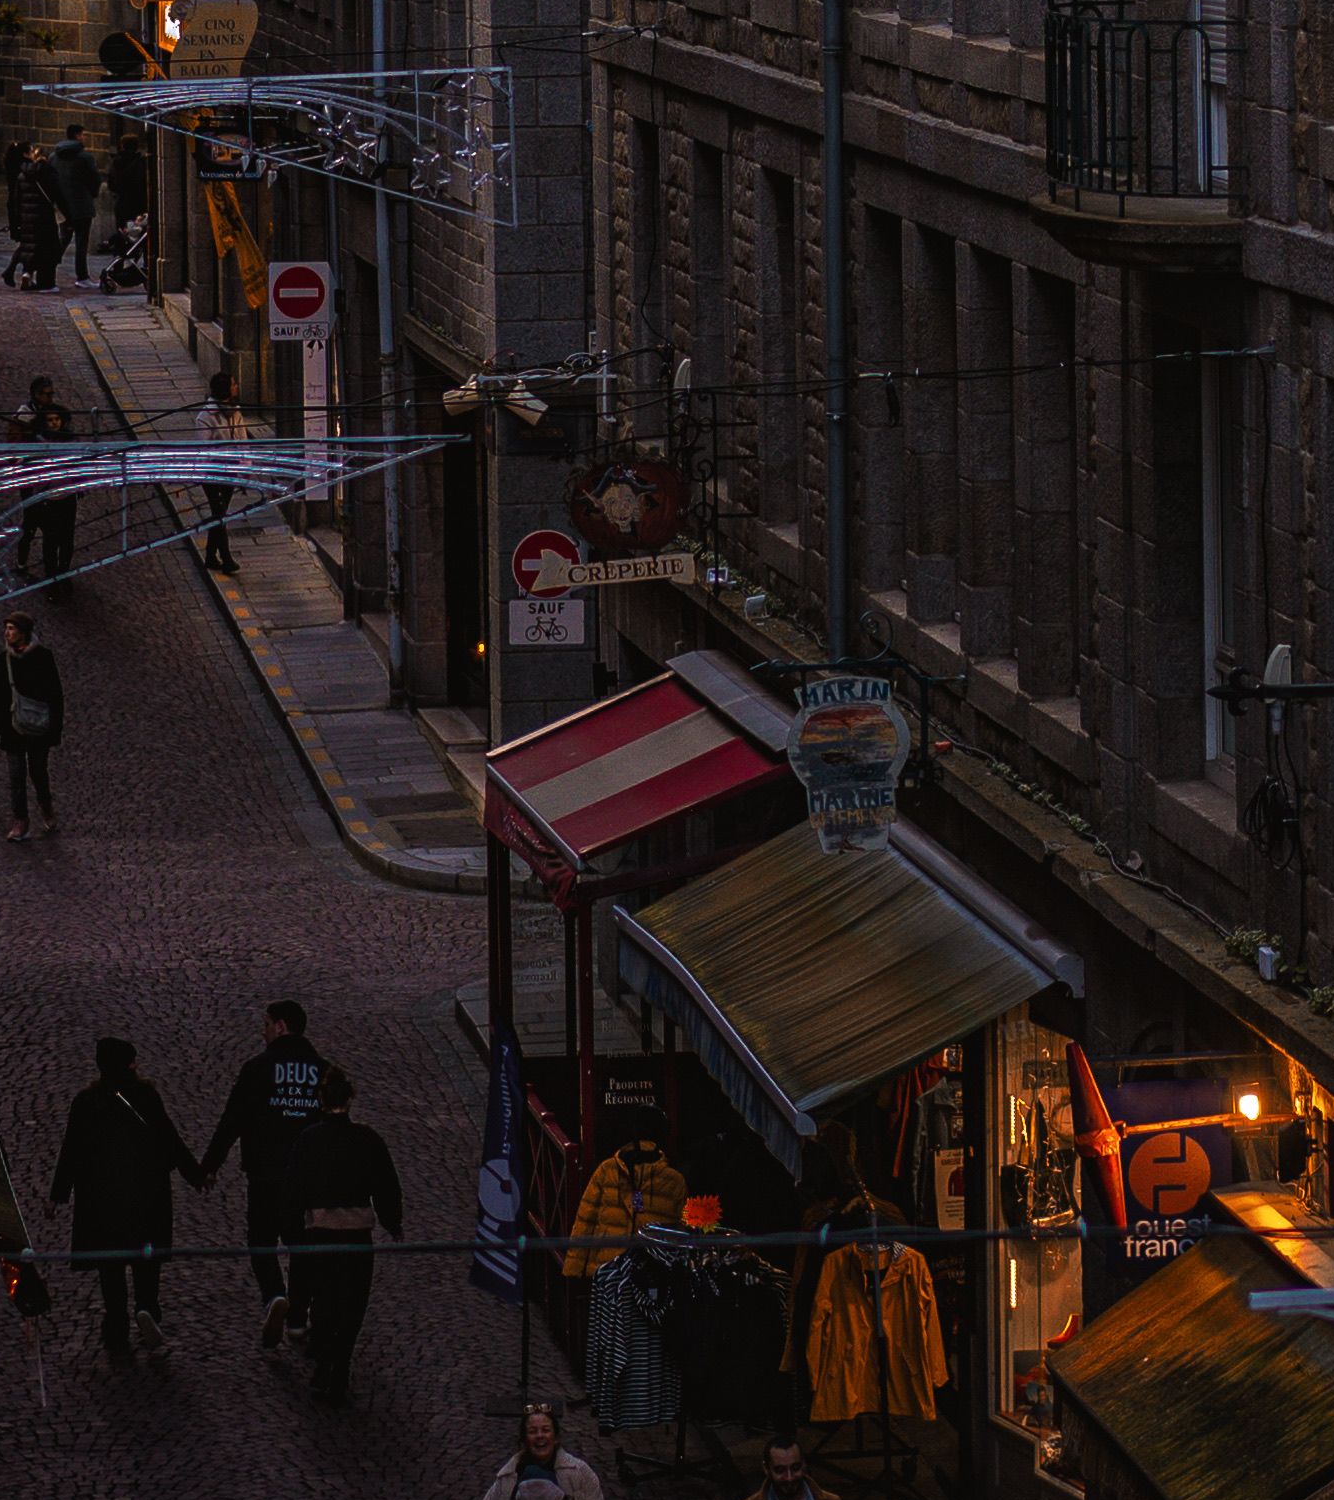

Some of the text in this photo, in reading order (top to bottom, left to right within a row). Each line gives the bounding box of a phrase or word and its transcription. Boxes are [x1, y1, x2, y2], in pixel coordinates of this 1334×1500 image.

[204, 19, 235, 32] CINQ
[183, 34, 244, 46] SEMAINES
[199, 49, 215, 59] EN
[180, 63, 230, 76] BALLON
[273, 327, 299, 337] SAUF
[528, 602, 565, 614] SAUF
[801, 681, 891, 707] MARIN
[810, 786, 894, 812] MARINE
[274, 1062, 319, 1086] DEUS
[608, 1077, 653, 1090] PRODUITS
[288, 1087, 303, 1096] EX
[268, 1096, 320, 1110] MACHINA
[604, 1091, 657, 1106] RÉGIONAUX
[1135, 1213, 1213, 1238] ouest
[1123, 1236, 1207, 1260] franc
